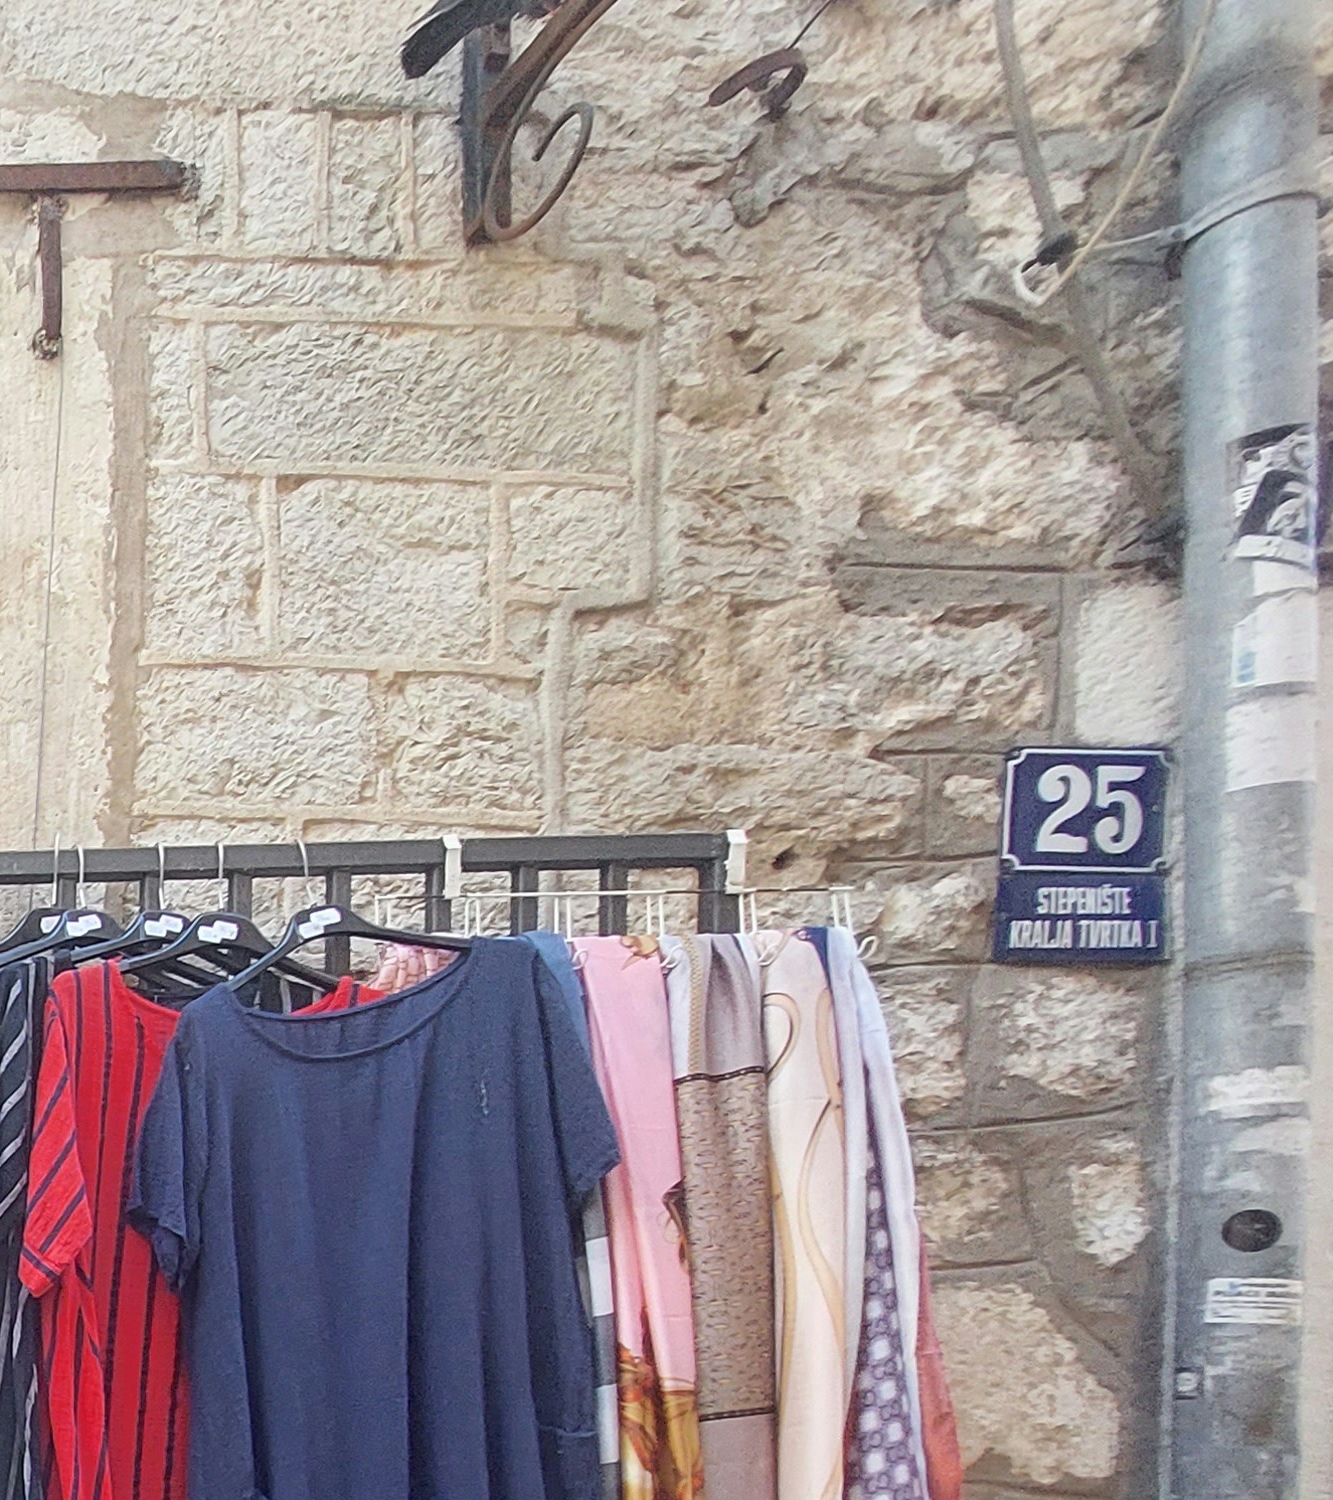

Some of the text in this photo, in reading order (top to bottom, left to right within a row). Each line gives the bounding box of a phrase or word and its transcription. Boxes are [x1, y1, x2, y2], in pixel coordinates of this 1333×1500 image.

[1036, 764, 1146, 855] 25
[1037, 884, 1132, 915] STEPENIŠTE
[1009, 920, 1159, 949] KRALJA TVRTKA I
